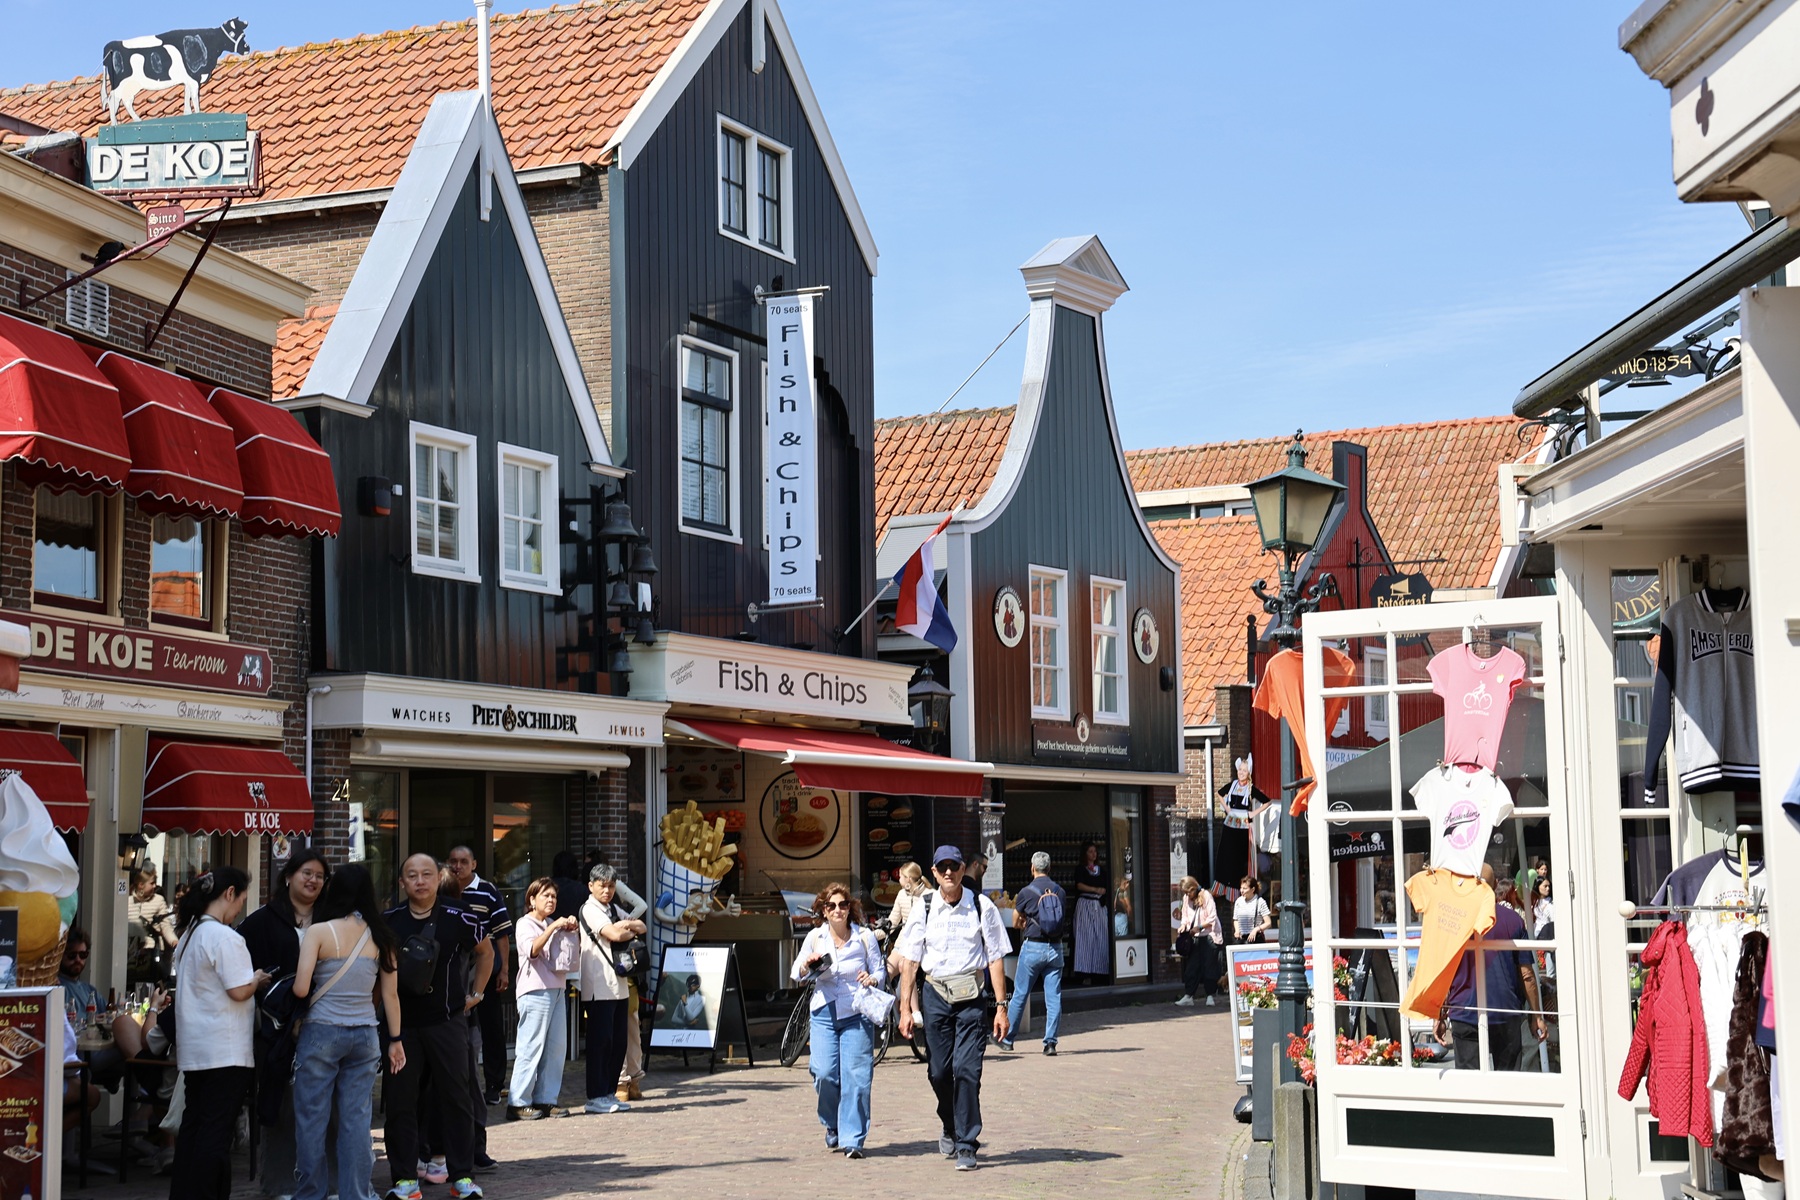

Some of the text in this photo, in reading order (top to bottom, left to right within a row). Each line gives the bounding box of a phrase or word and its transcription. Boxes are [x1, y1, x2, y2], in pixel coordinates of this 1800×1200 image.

[91, 141, 249, 182] DE KOE
[148, 213, 177, 225] Since
[770, 304, 808, 316] 70 seats
[1611, 353, 1692, 375] NNO 1854
[776, 324, 802, 576] Fish & Chips
[773, 586, 812, 597] 70 seats
[30, 622, 228, 675] DE KOE Tea-room
[718, 660, 768, 694] Fish
[777, 672, 795, 697] &
[803, 671, 868, 706] Chips
[392, 707, 451, 724] WATCHES
[472, 704, 502, 727] PIET
[517, 710, 579, 735] SCHILDER
[608, 724, 646, 737] JEWELS
[899, 738, 912, 746] only
[331, 778, 350, 802] 24
[244, 812, 280, 829] DE KOE
[118, 881, 127, 892] 26
[947, 920, 971, 929] STRAUSS
